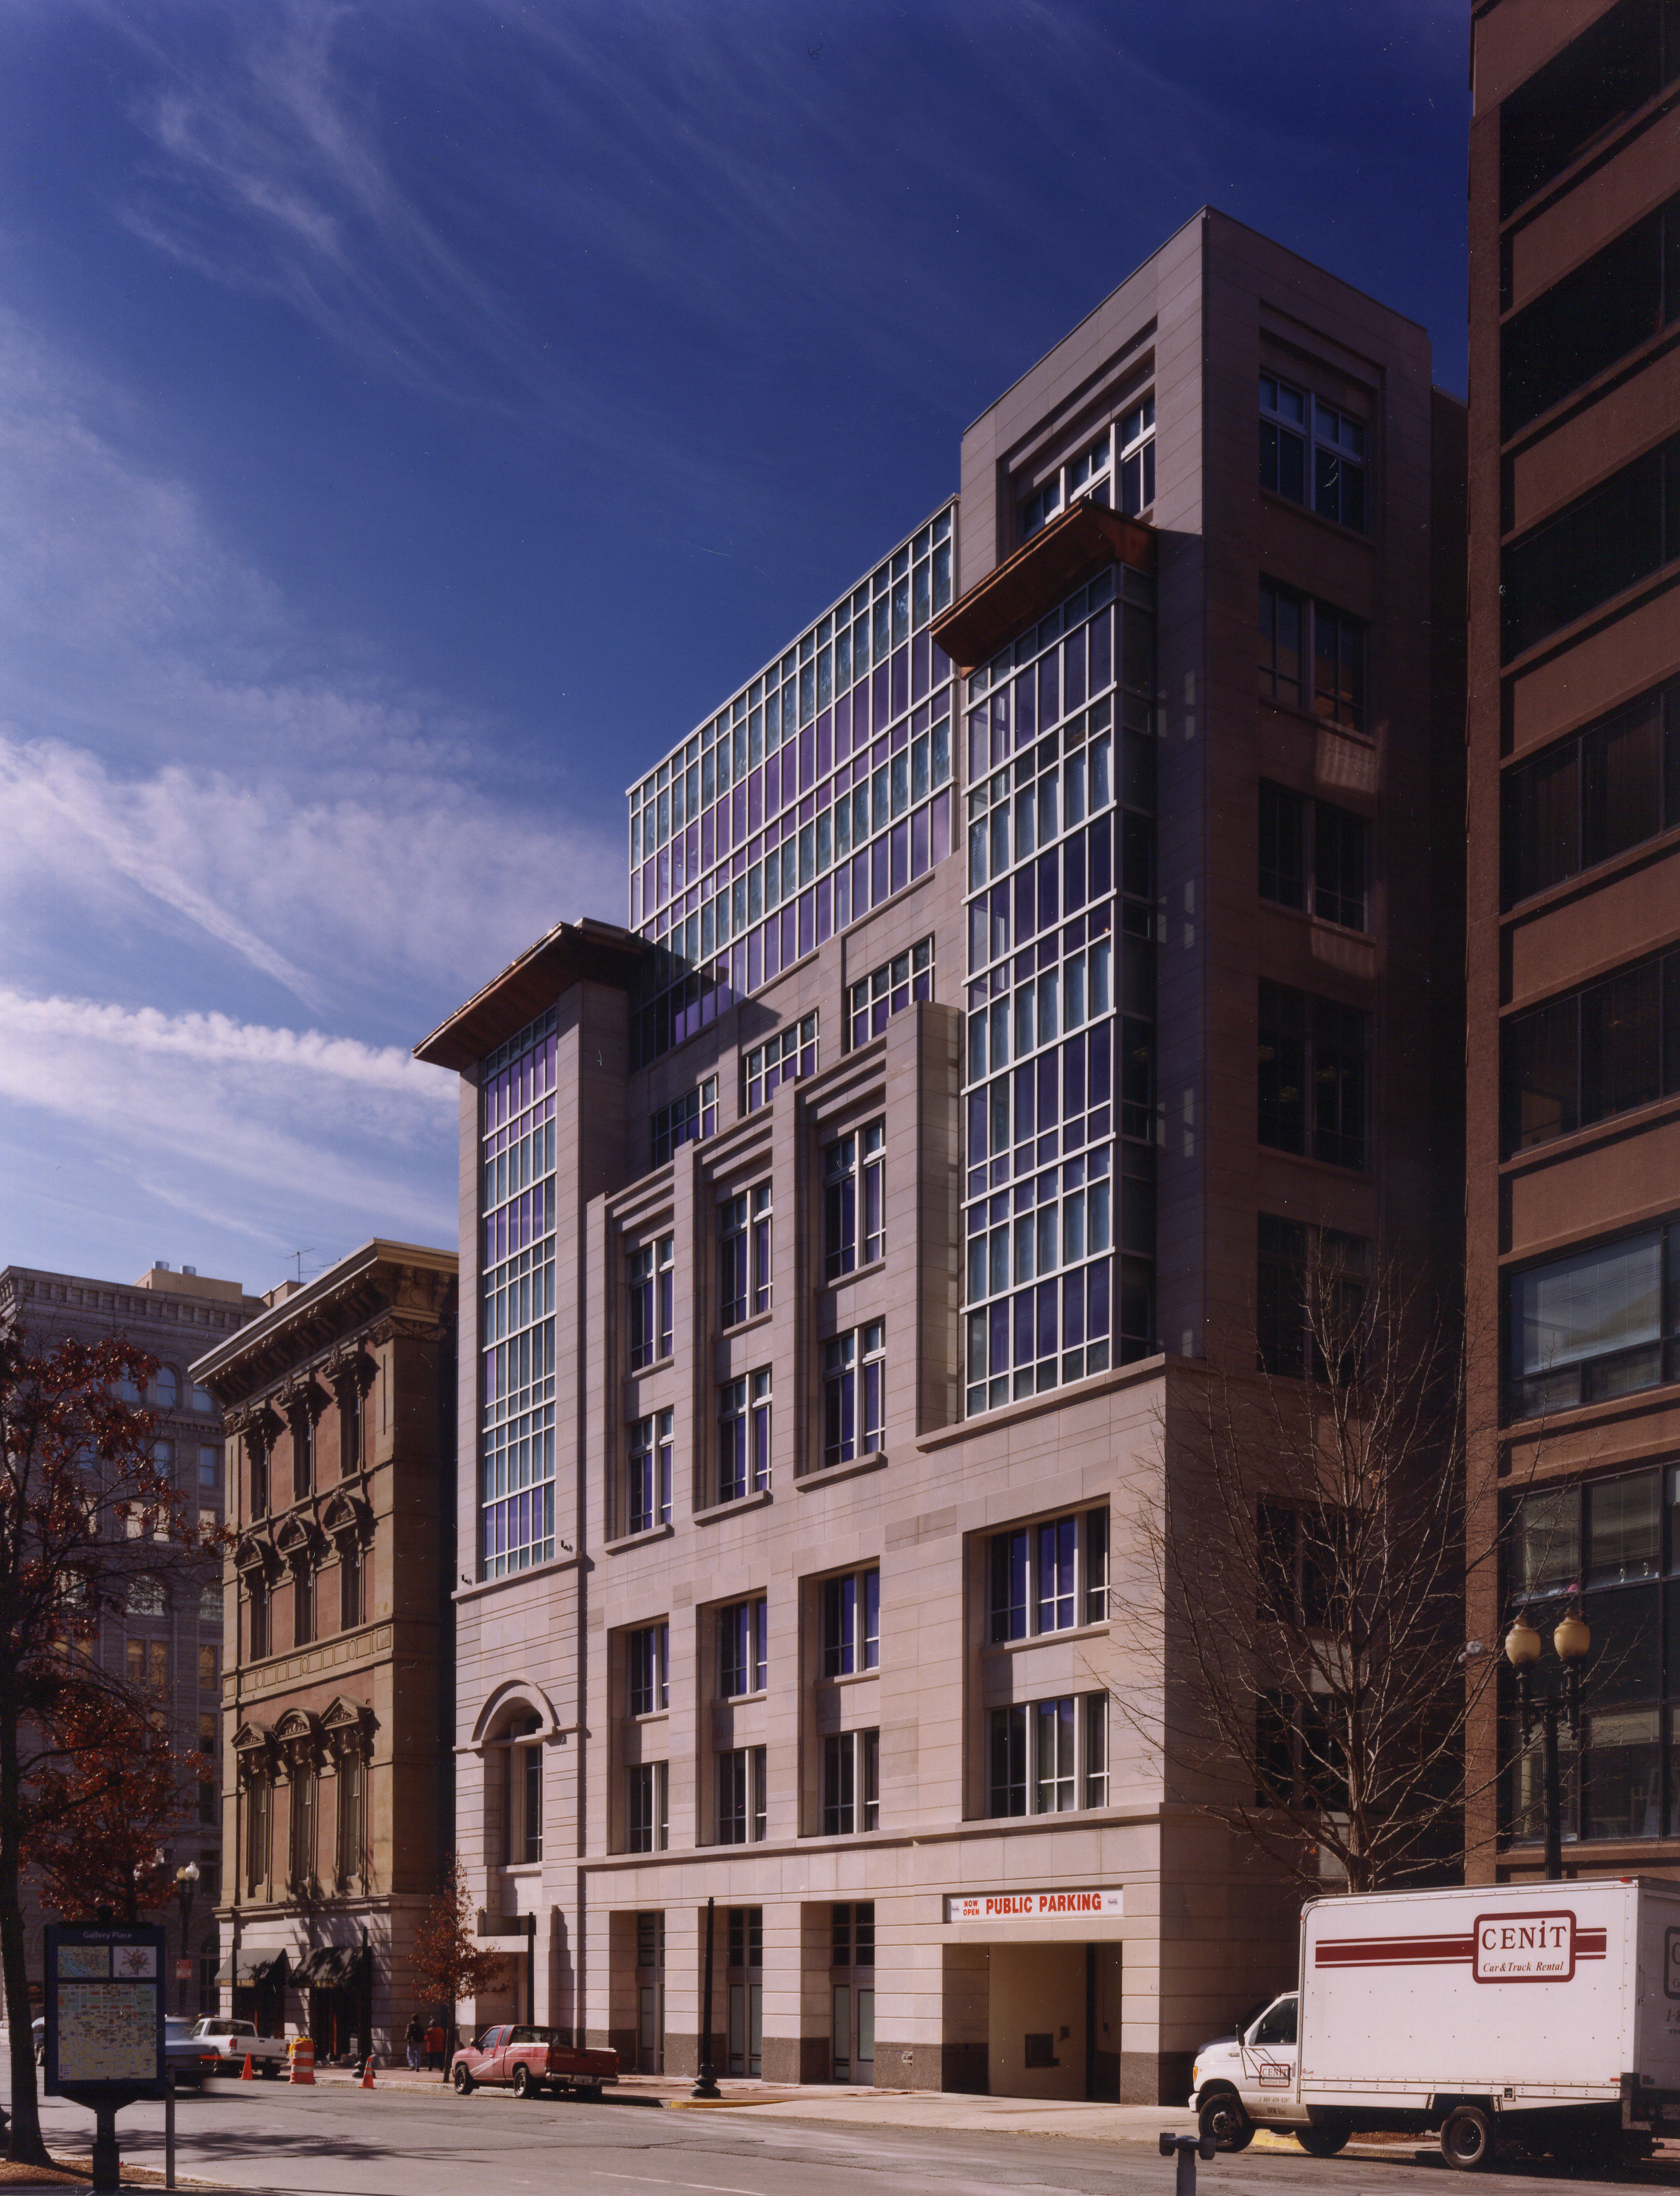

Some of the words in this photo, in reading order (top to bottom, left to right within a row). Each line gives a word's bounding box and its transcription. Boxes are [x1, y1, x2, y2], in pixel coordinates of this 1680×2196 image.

[986, 1896, 1033, 1915] PUBLIC
[1039, 1893, 1101, 1913] PARKING
[963, 1908, 980, 1916] OPEN
[83, 1931, 111, 1940] Gallery
[1536, 1961, 1564, 1971] Rental
